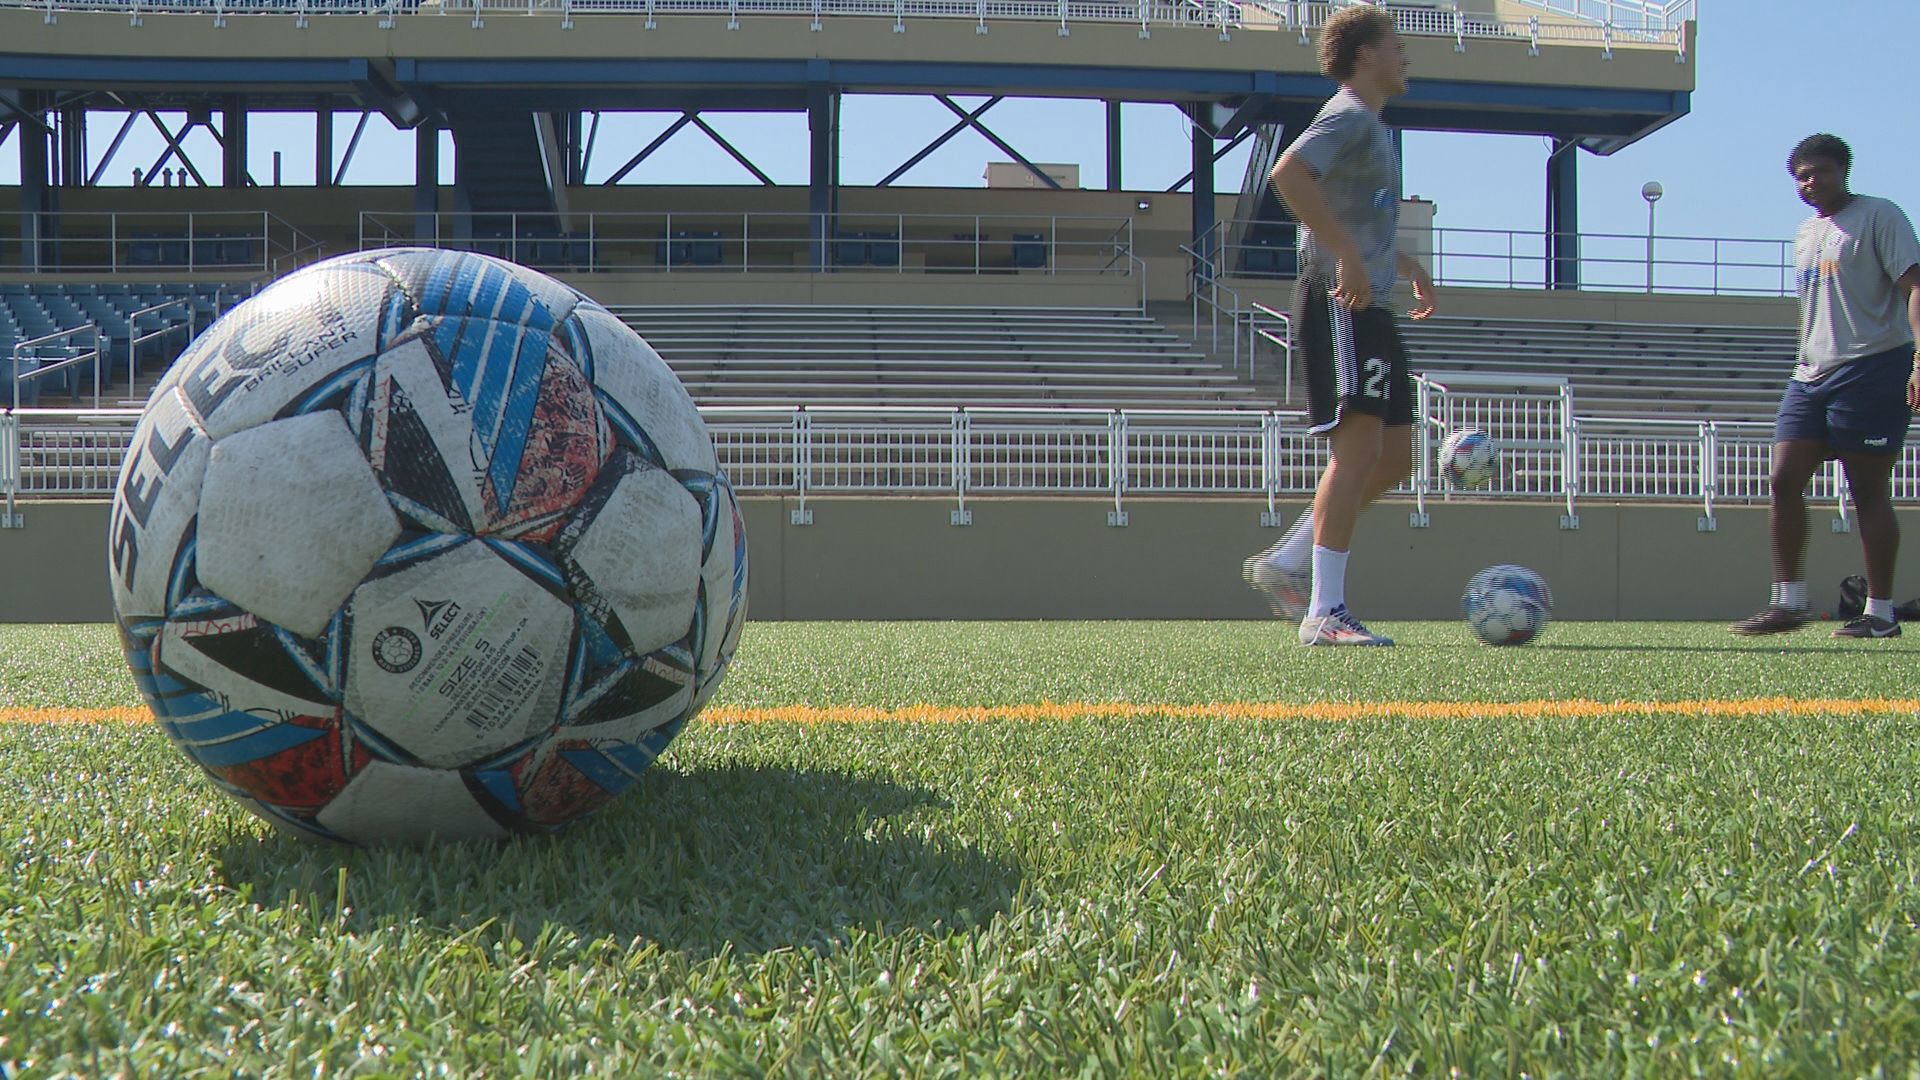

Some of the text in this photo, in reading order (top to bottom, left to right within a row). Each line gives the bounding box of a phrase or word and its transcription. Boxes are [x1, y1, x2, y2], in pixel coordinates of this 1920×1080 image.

[282, 331, 359, 378] SUPER
[429, 602, 460, 639] SELECT
[408, 644, 448, 690] RECOMMENDED
[445, 612, 473, 645] PRESSURE
[438, 638, 489, 697] SIZE 5
[490, 631, 517, 665] GLOSTRUP
[450, 646, 496, 702] SELECT SPORT A/S
